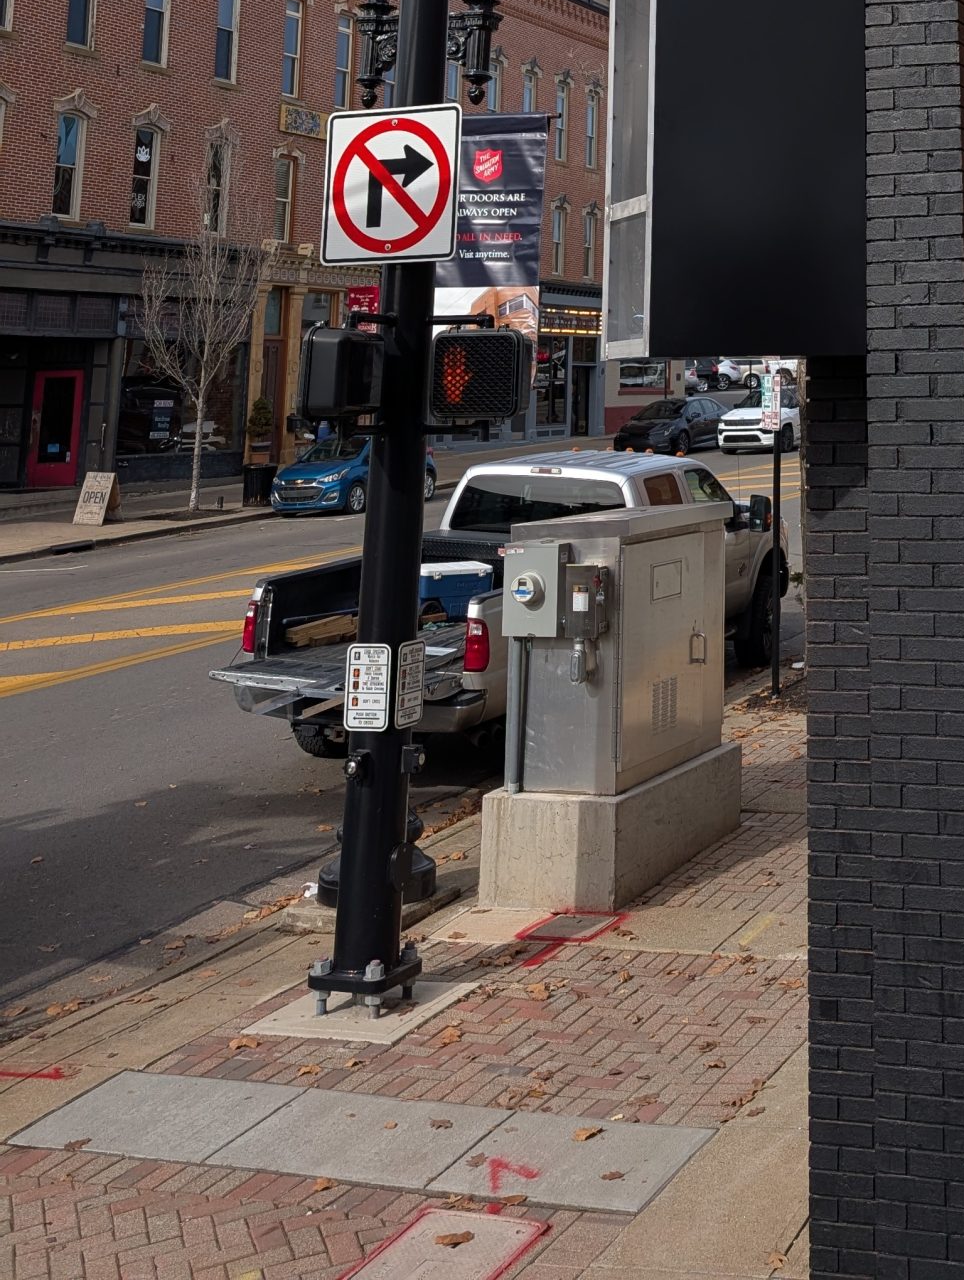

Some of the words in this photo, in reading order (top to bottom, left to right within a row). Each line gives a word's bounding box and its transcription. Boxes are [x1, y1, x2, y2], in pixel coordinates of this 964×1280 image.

[480, 152, 491, 162] THE
[469, 193, 505, 203] DOORS
[506, 193, 526, 201] ARE
[491, 208, 518, 216] OPEN
[462, 232, 476, 241] ALL
[480, 232, 491, 241] IN
[494, 231, 523, 241] NEED.
[459, 249, 474, 259] Visit
[475, 249, 510, 261] anytime.
[82, 491, 107, 504] OPEN
